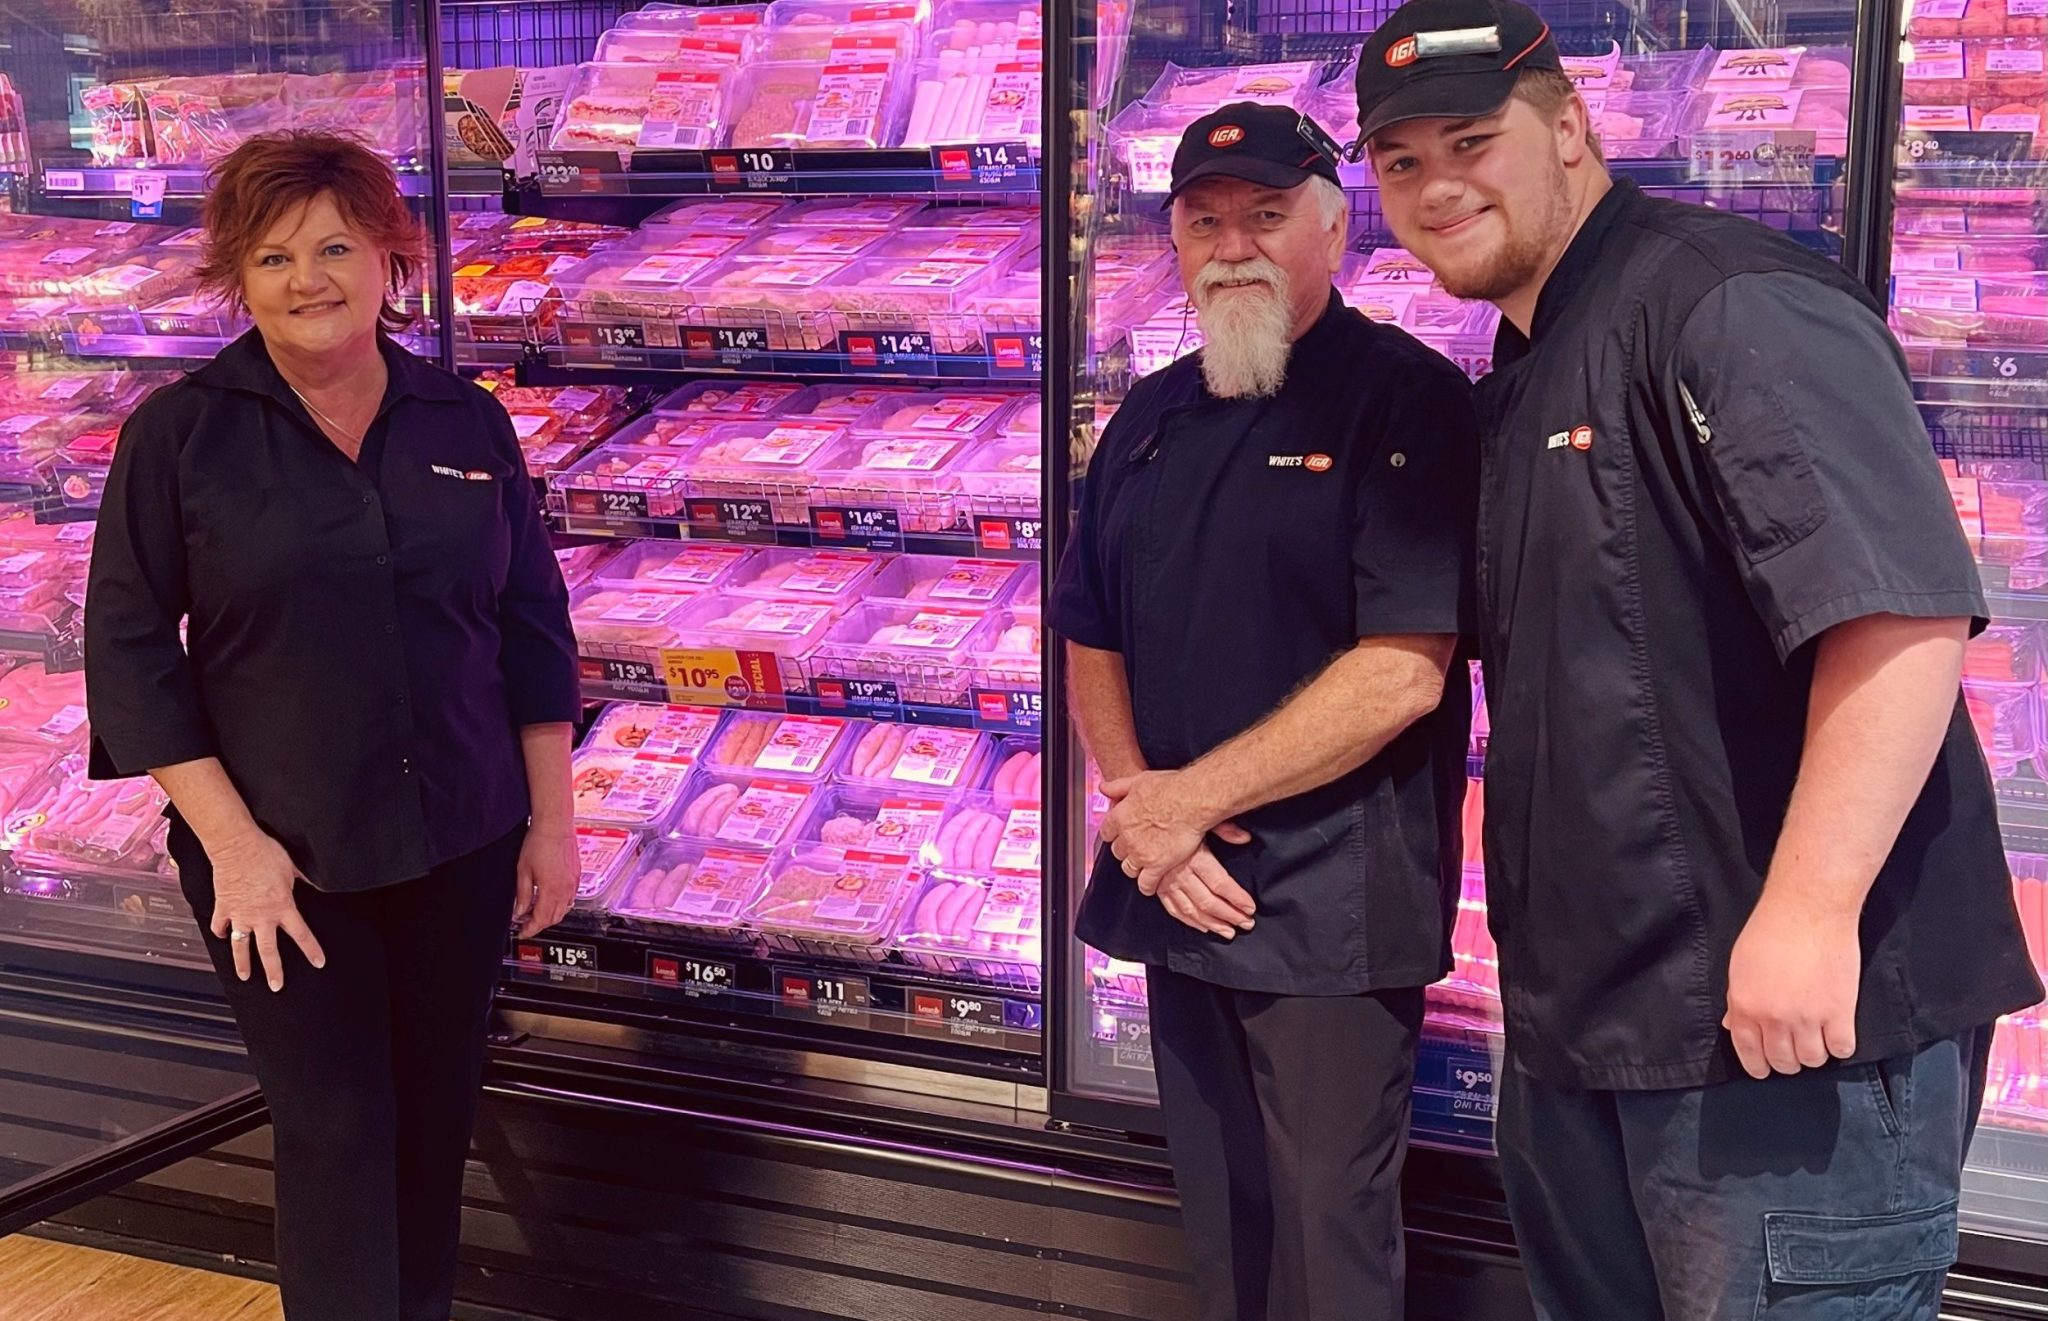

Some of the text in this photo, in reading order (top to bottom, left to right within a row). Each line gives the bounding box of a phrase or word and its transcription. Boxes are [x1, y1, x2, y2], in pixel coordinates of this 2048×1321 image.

[1212, 129, 1240, 143] IGA
[743, 153, 774, 171] $10
[975, 146, 1009, 165] $14
[1992, 356, 2018, 377] $6
[1269, 455, 1330, 468] WHITE'S IGA
[817, 979, 844, 1000] $11
